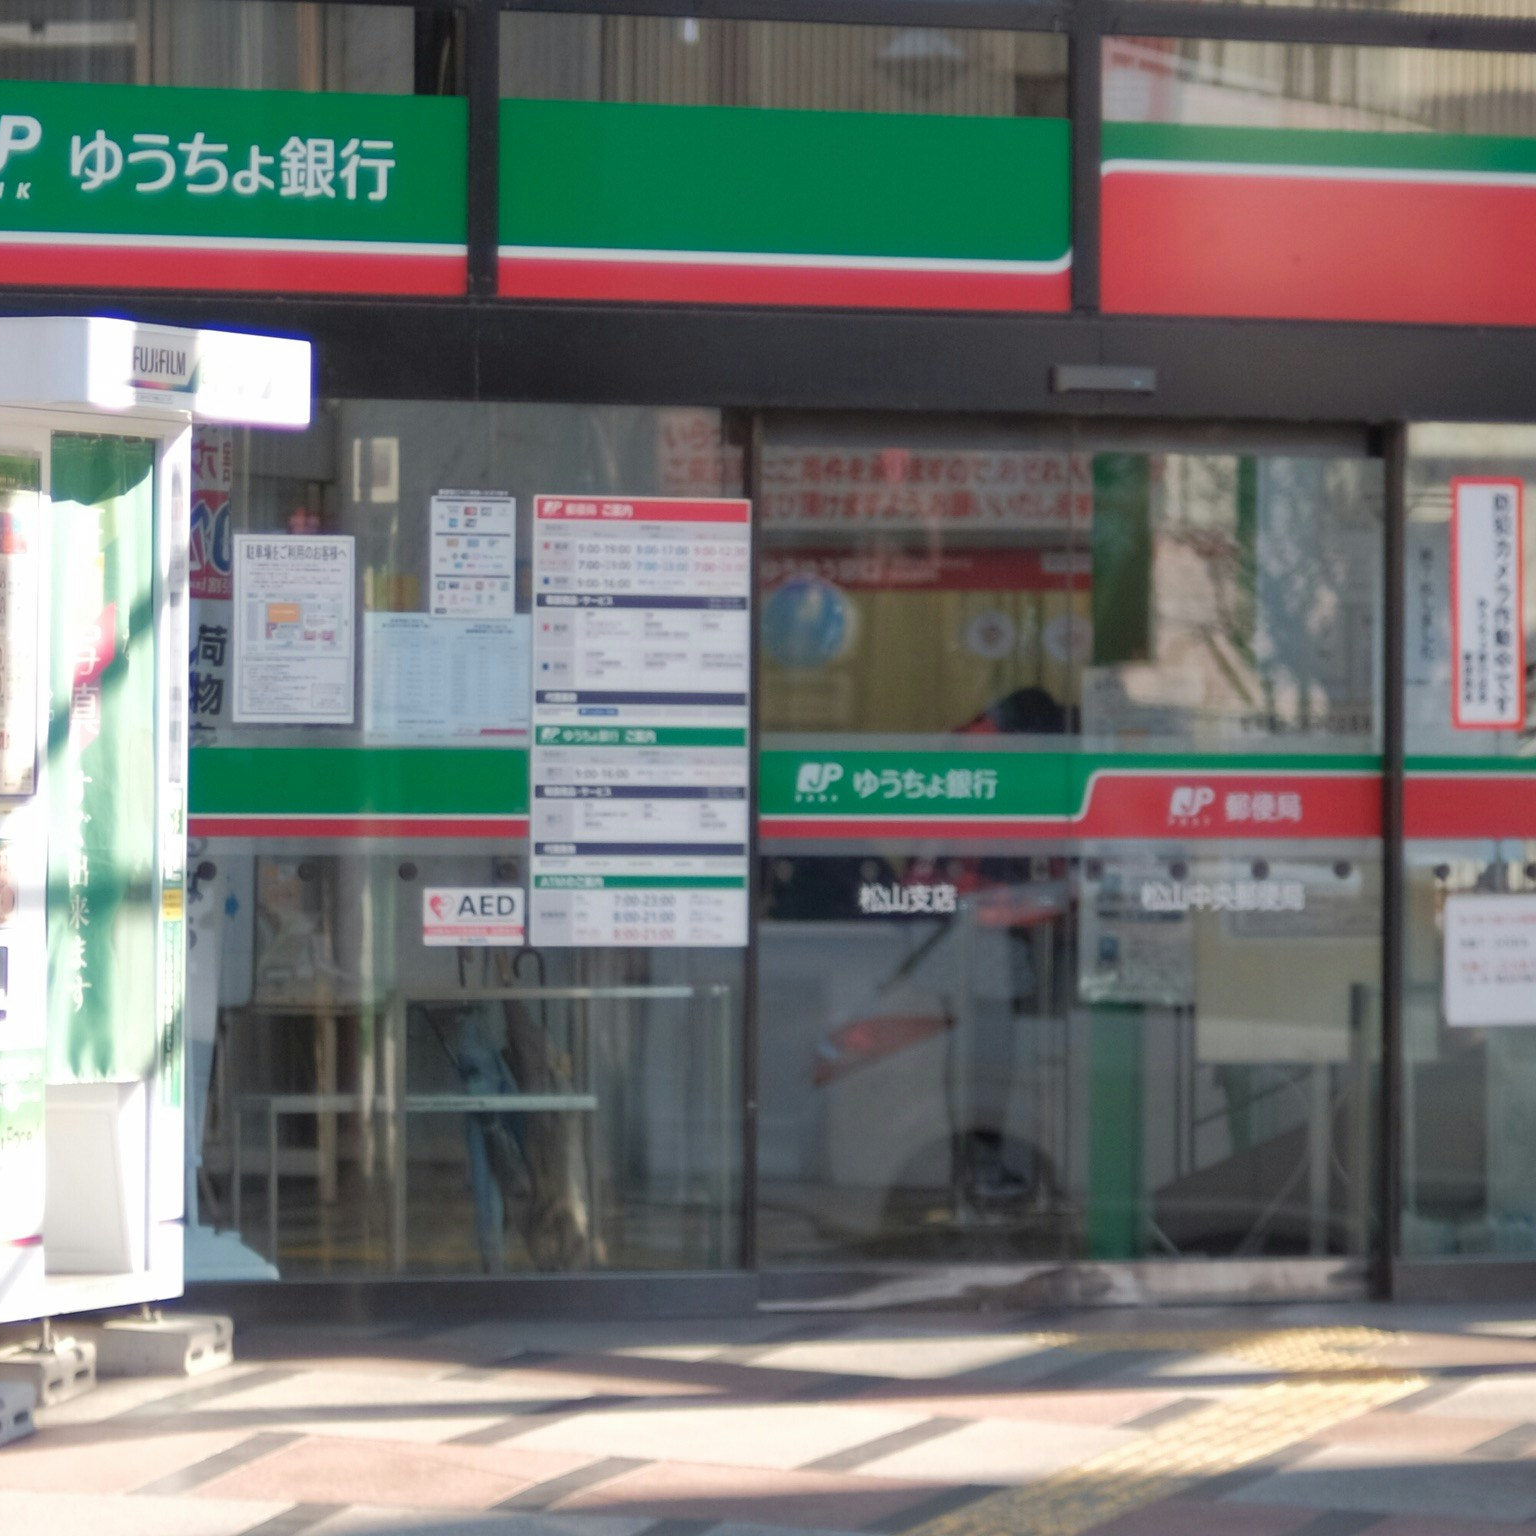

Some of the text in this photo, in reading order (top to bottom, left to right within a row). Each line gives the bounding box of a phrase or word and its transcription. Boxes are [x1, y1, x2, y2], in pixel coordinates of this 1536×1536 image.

[69, 129, 396, 201] ゆうちょ銀行
[132, 345, 186, 376] FUJIFILM
[852, 768, 999, 800] ゆうちょ銀行
[456, 894, 516, 917] AED
